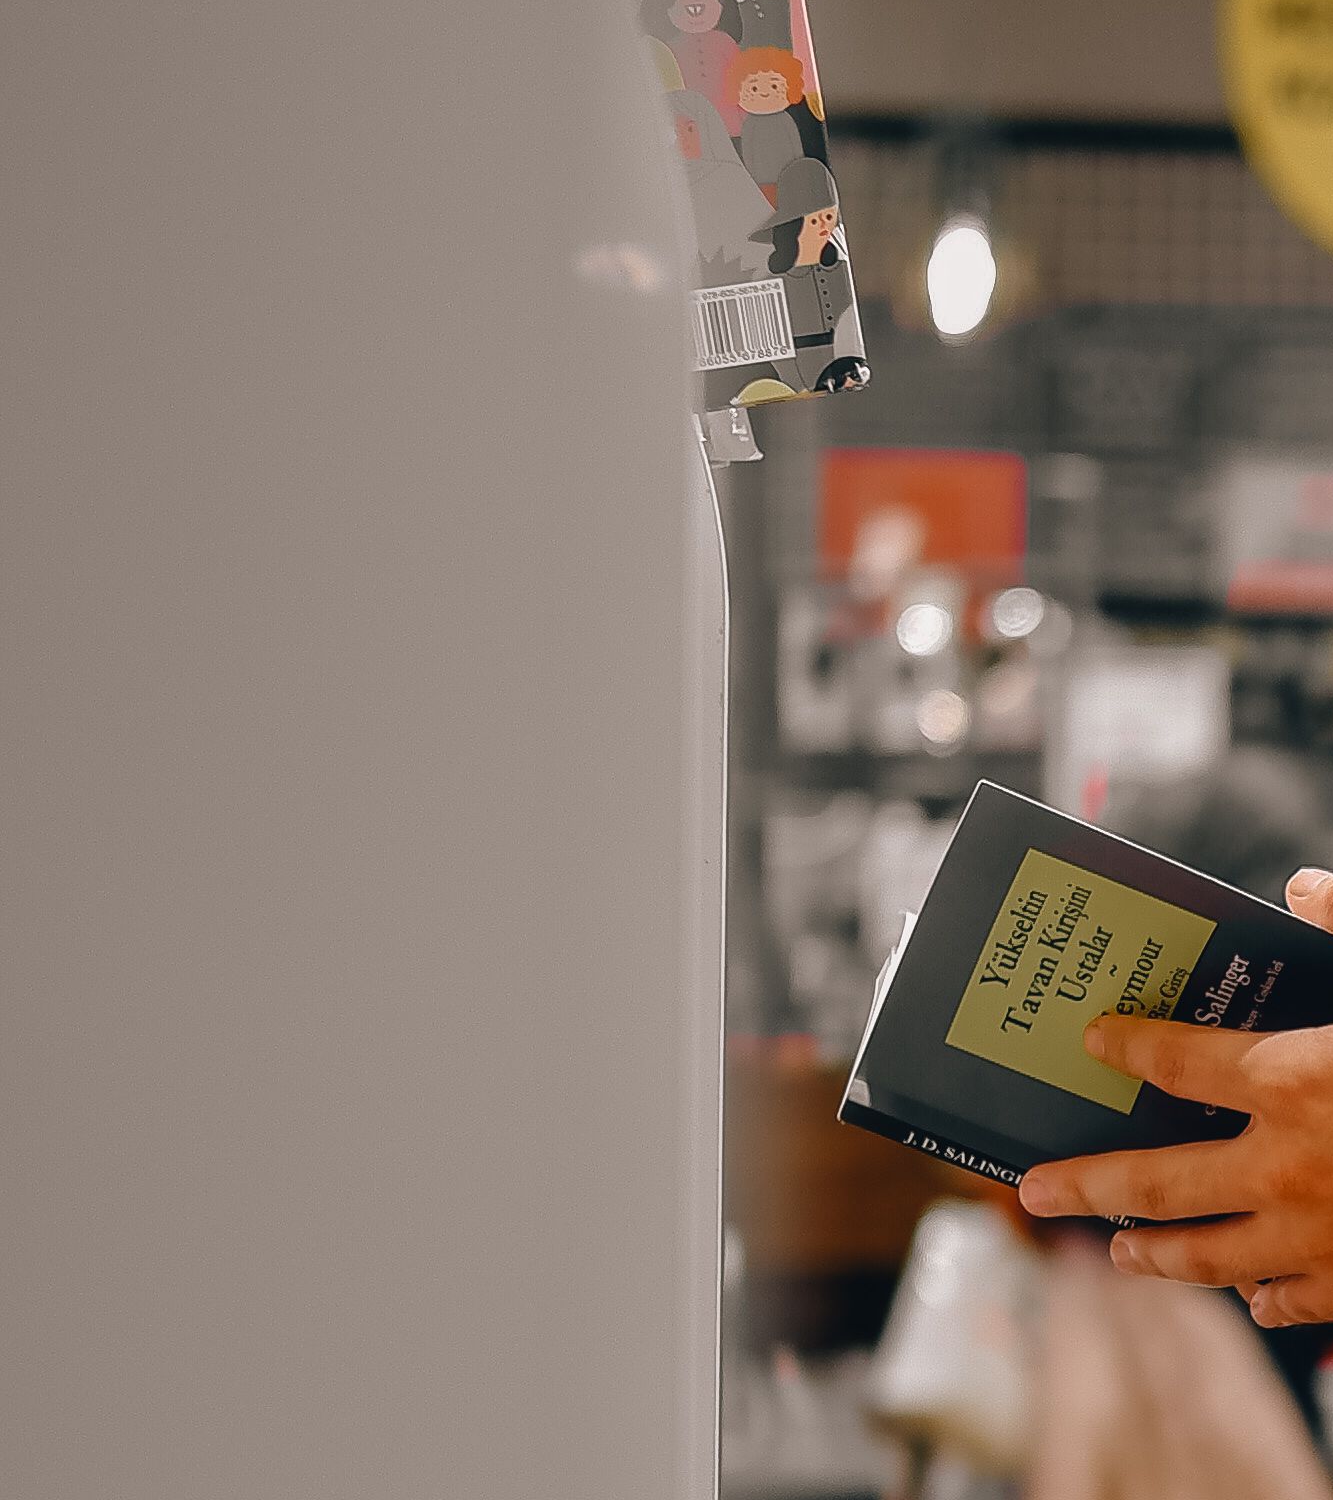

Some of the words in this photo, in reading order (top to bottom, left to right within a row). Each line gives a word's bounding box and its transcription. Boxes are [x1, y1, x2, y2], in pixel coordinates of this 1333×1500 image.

[741, 346, 788, 361] 678876
[979, 888, 1049, 989] Yükseltin
[1000, 953, 1060, 1035] Tavan
[1037, 883, 1093, 956] Kirişini
[1054, 925, 1114, 1003] Ustalar
[1102, 937, 1164, 1018] eymour
[1158, 967, 1191, 999] Giriş
[1194, 954, 1251, 1029] Salinger
[902, 1130, 918, 1145] J.
[921, 1136, 941, 1156] D.
